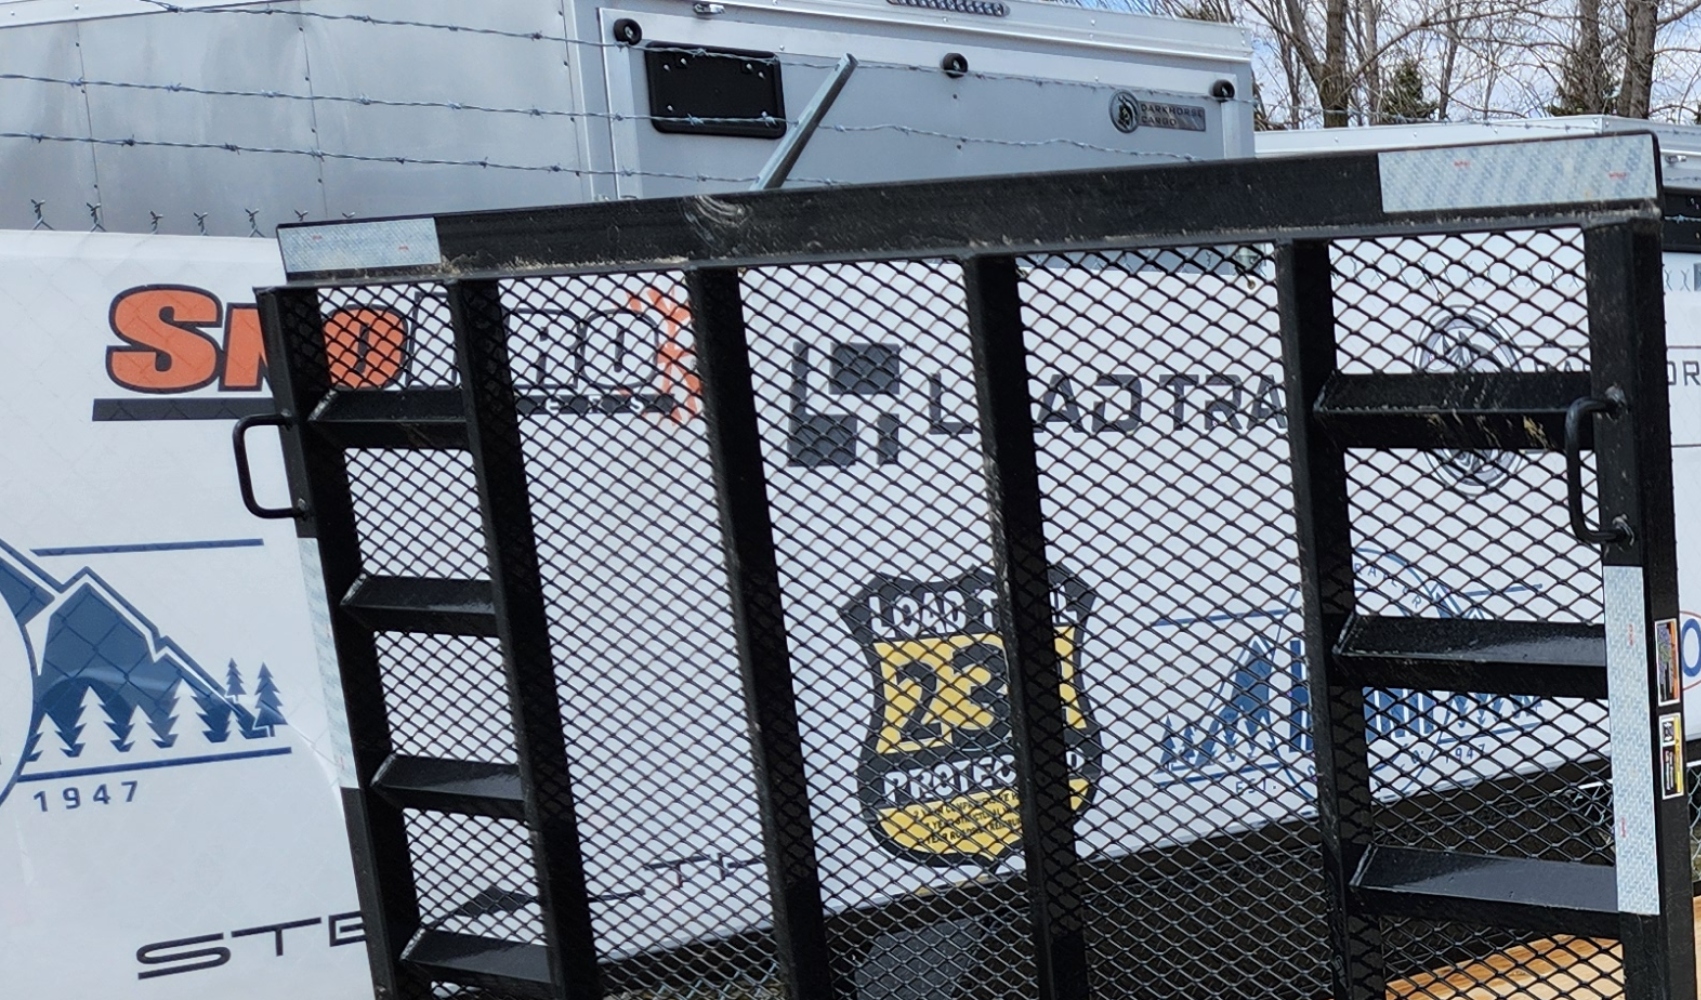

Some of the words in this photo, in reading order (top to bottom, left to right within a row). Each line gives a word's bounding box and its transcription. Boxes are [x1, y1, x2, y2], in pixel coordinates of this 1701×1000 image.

[1140, 103, 1204, 118] DARKHORSE
[1140, 116, 1177, 127] CARGO
[33, 779, 139, 813] 1947
